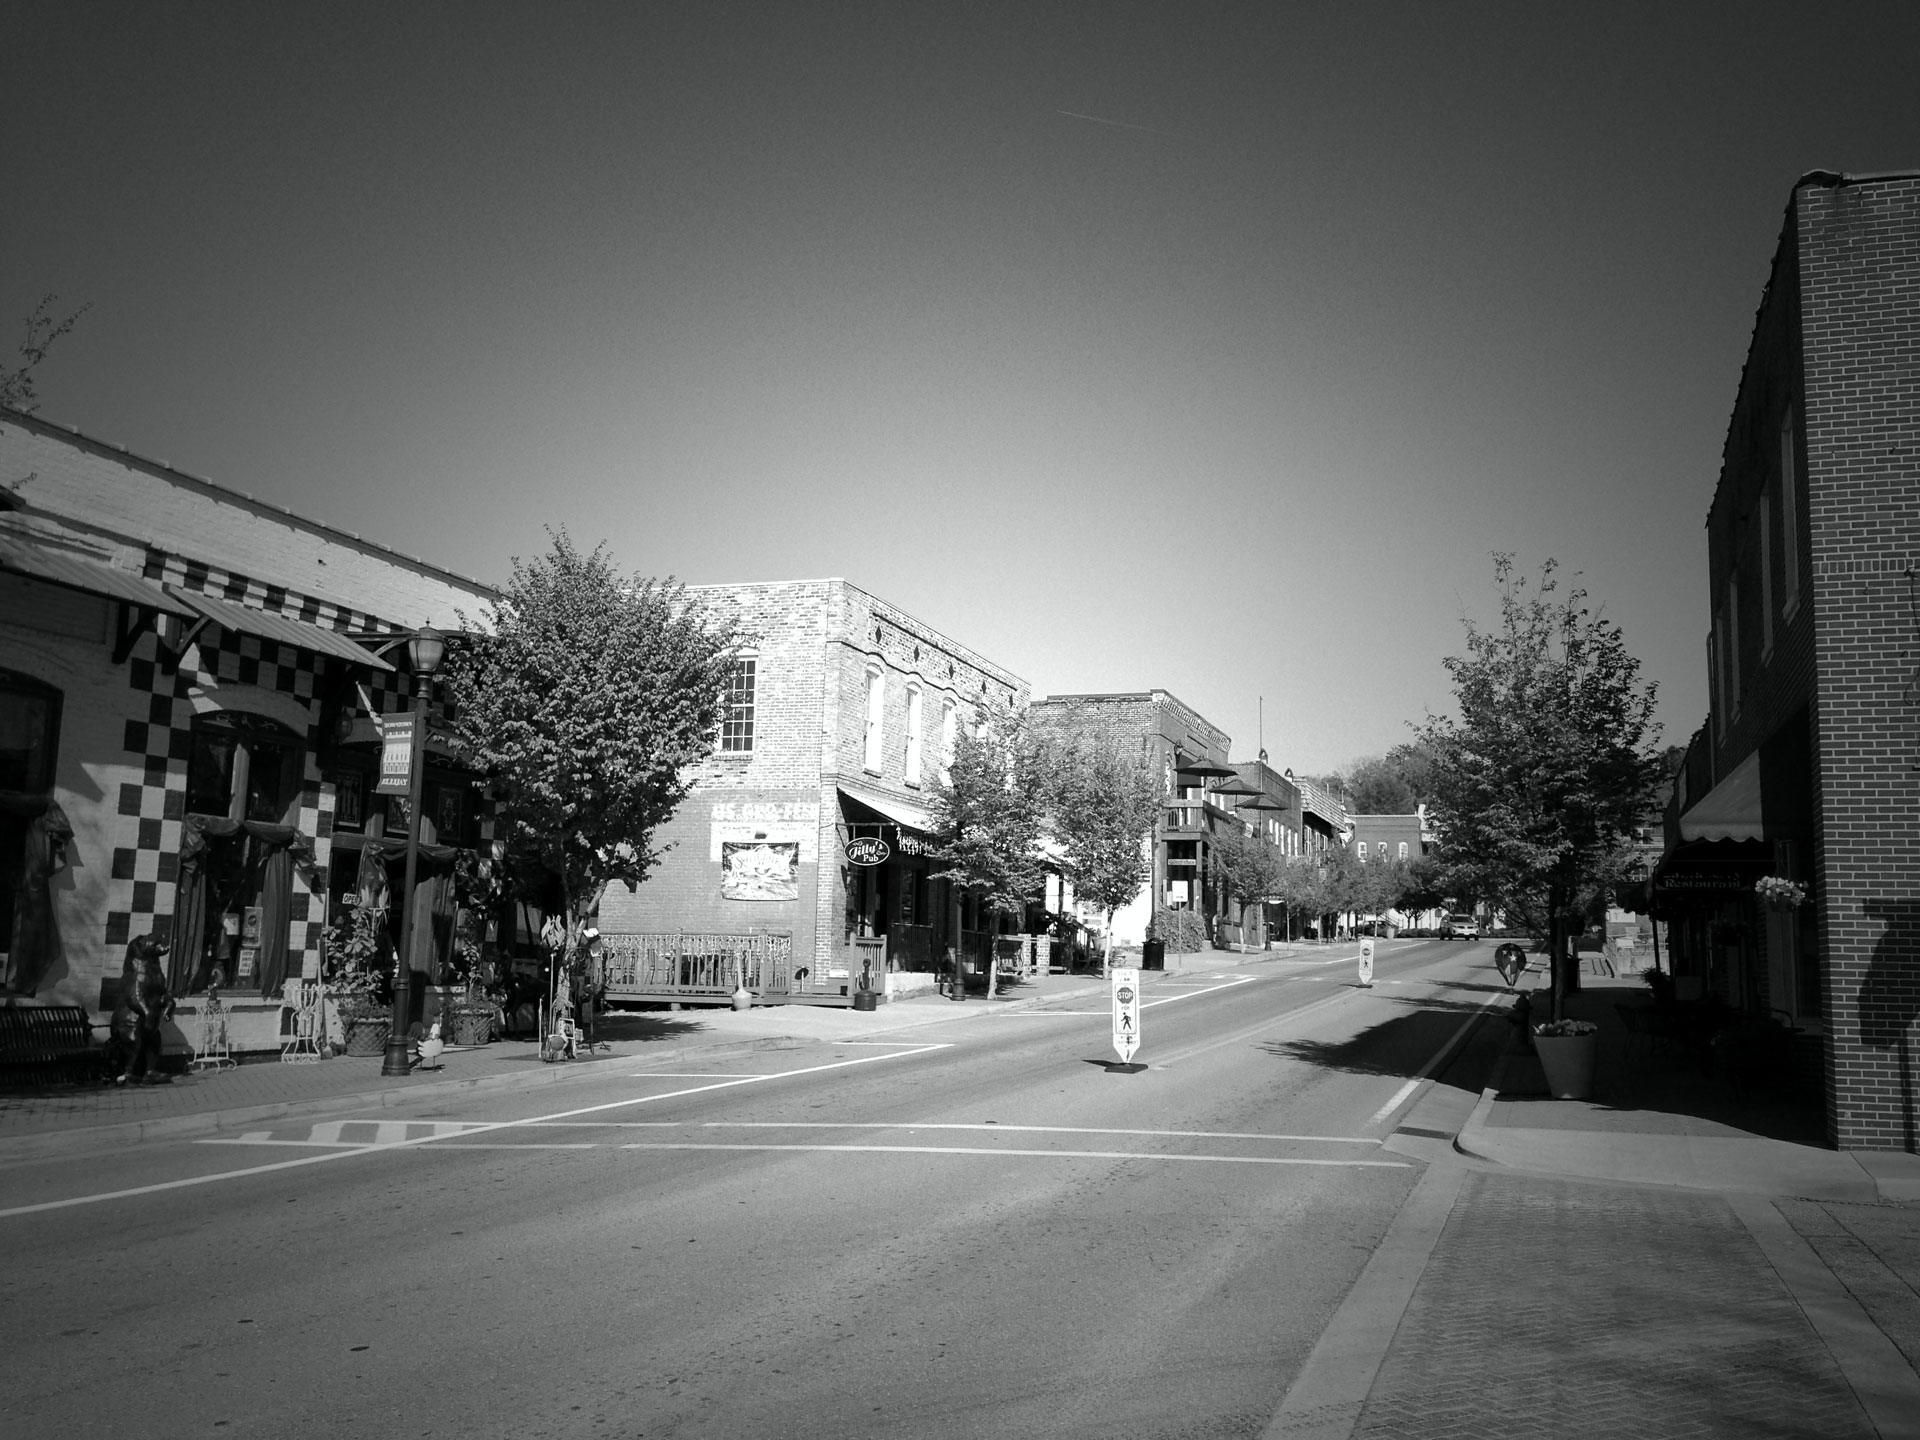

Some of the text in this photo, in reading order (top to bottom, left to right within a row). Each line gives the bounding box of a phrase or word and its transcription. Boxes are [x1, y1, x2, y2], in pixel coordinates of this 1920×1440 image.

[381, 778, 409, 787] ELLIJAY
[848, 840, 883, 860] Jilly's
[863, 854, 879, 862] Pub
[1664, 878, 1741, 888] Restaurant
[344, 894, 359, 904] OPEN
[1118, 991, 1133, 1000] STOP
